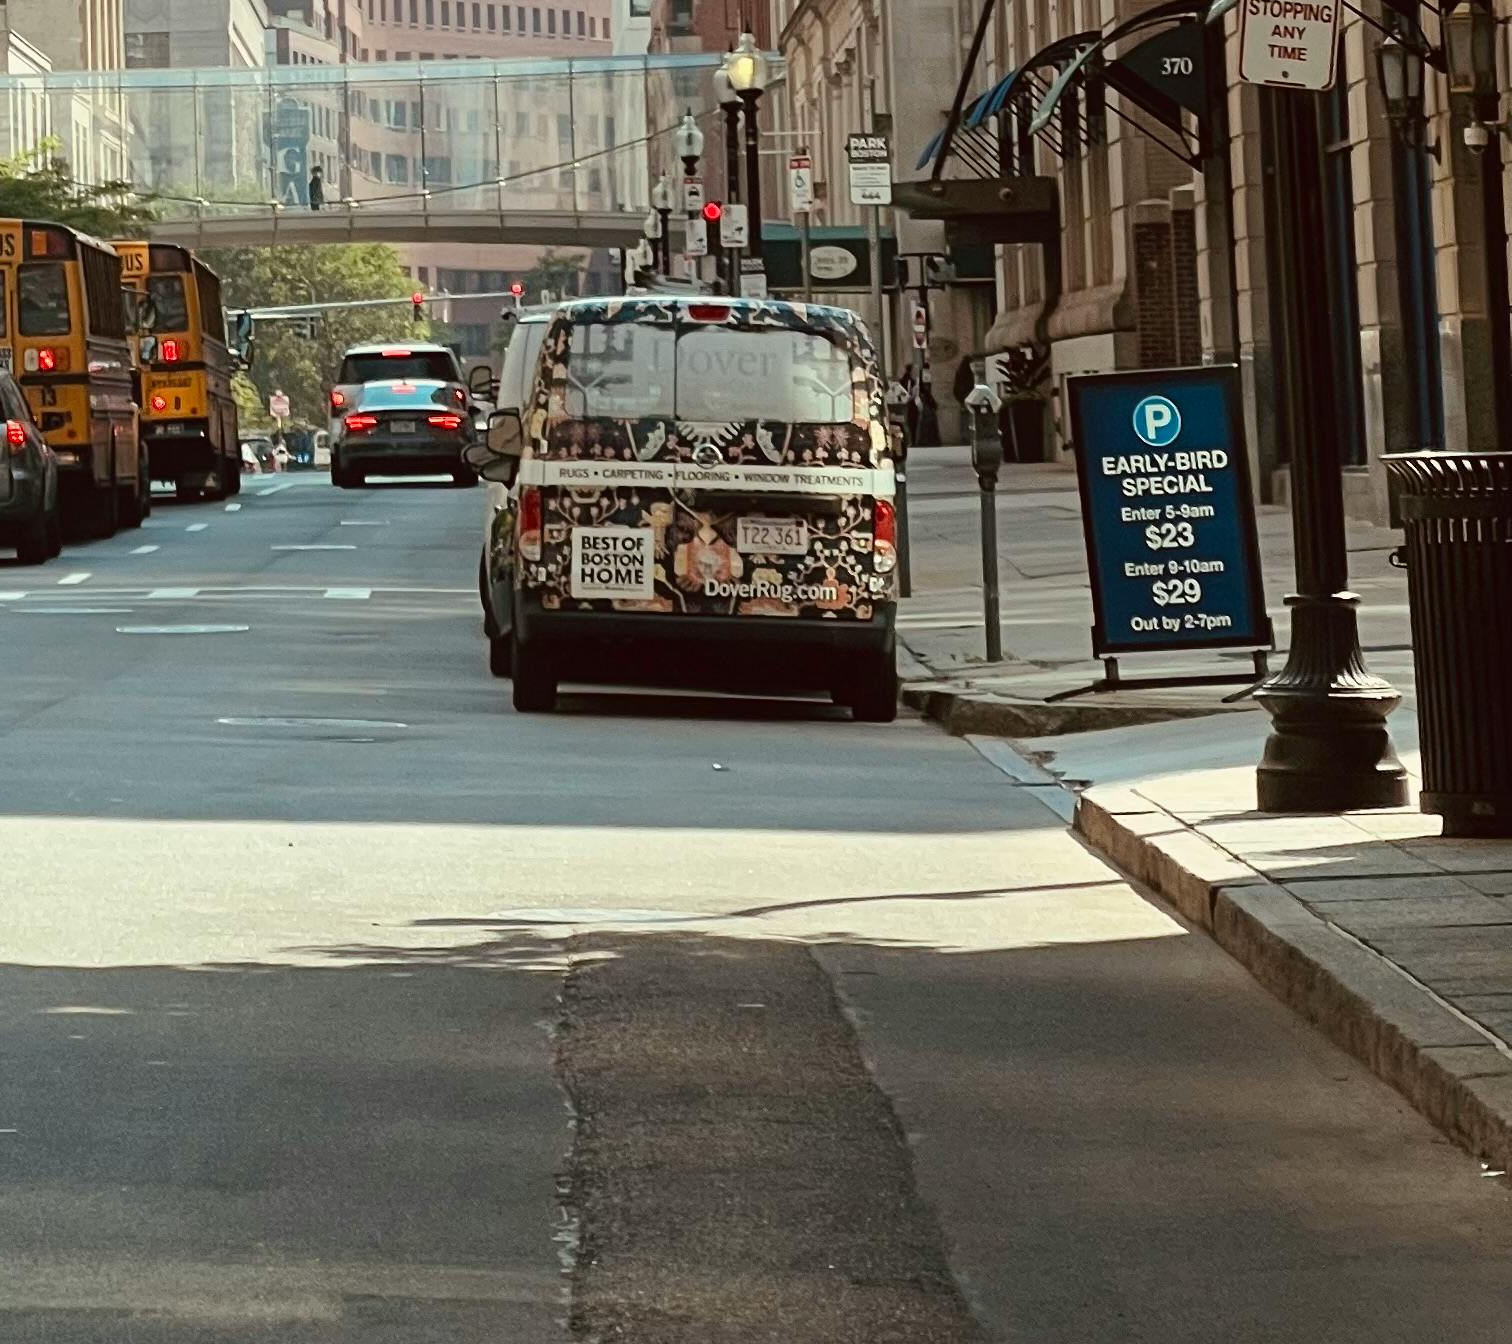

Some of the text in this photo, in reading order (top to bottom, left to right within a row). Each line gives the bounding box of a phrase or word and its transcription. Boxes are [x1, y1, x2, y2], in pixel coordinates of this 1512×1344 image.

[1271, 24, 1307, 40] ANY
[1268, 44, 1308, 61] TIME
[1161, 57, 1193, 75] 370
[850, 137, 887, 151] PARK
[121, 253, 144, 271] US
[1144, 404, 1172, 440] P
[1102, 449, 1228, 475] EARLY-BIRD
[560, 468, 864, 486] RUGS CARPETING FLOORING WINDOW TREATMENTS
[1122, 474, 1213, 497] SPECIAL
[1121, 503, 1215, 522] Enter 5-9am
[581, 535, 644, 551] BEST OF
[742, 526, 803, 545] T22 361
[1145, 523, 1195, 550] $23
[581, 552, 644, 567] BOSTON
[1125, 559, 1225, 577] Enter 9-10am
[581, 568, 644, 584] HOME
[704, 577, 837, 602] DoverRug.com
[1152, 579, 1202, 606] $29
[1131, 613, 1232, 632] Out by 2-7pm
